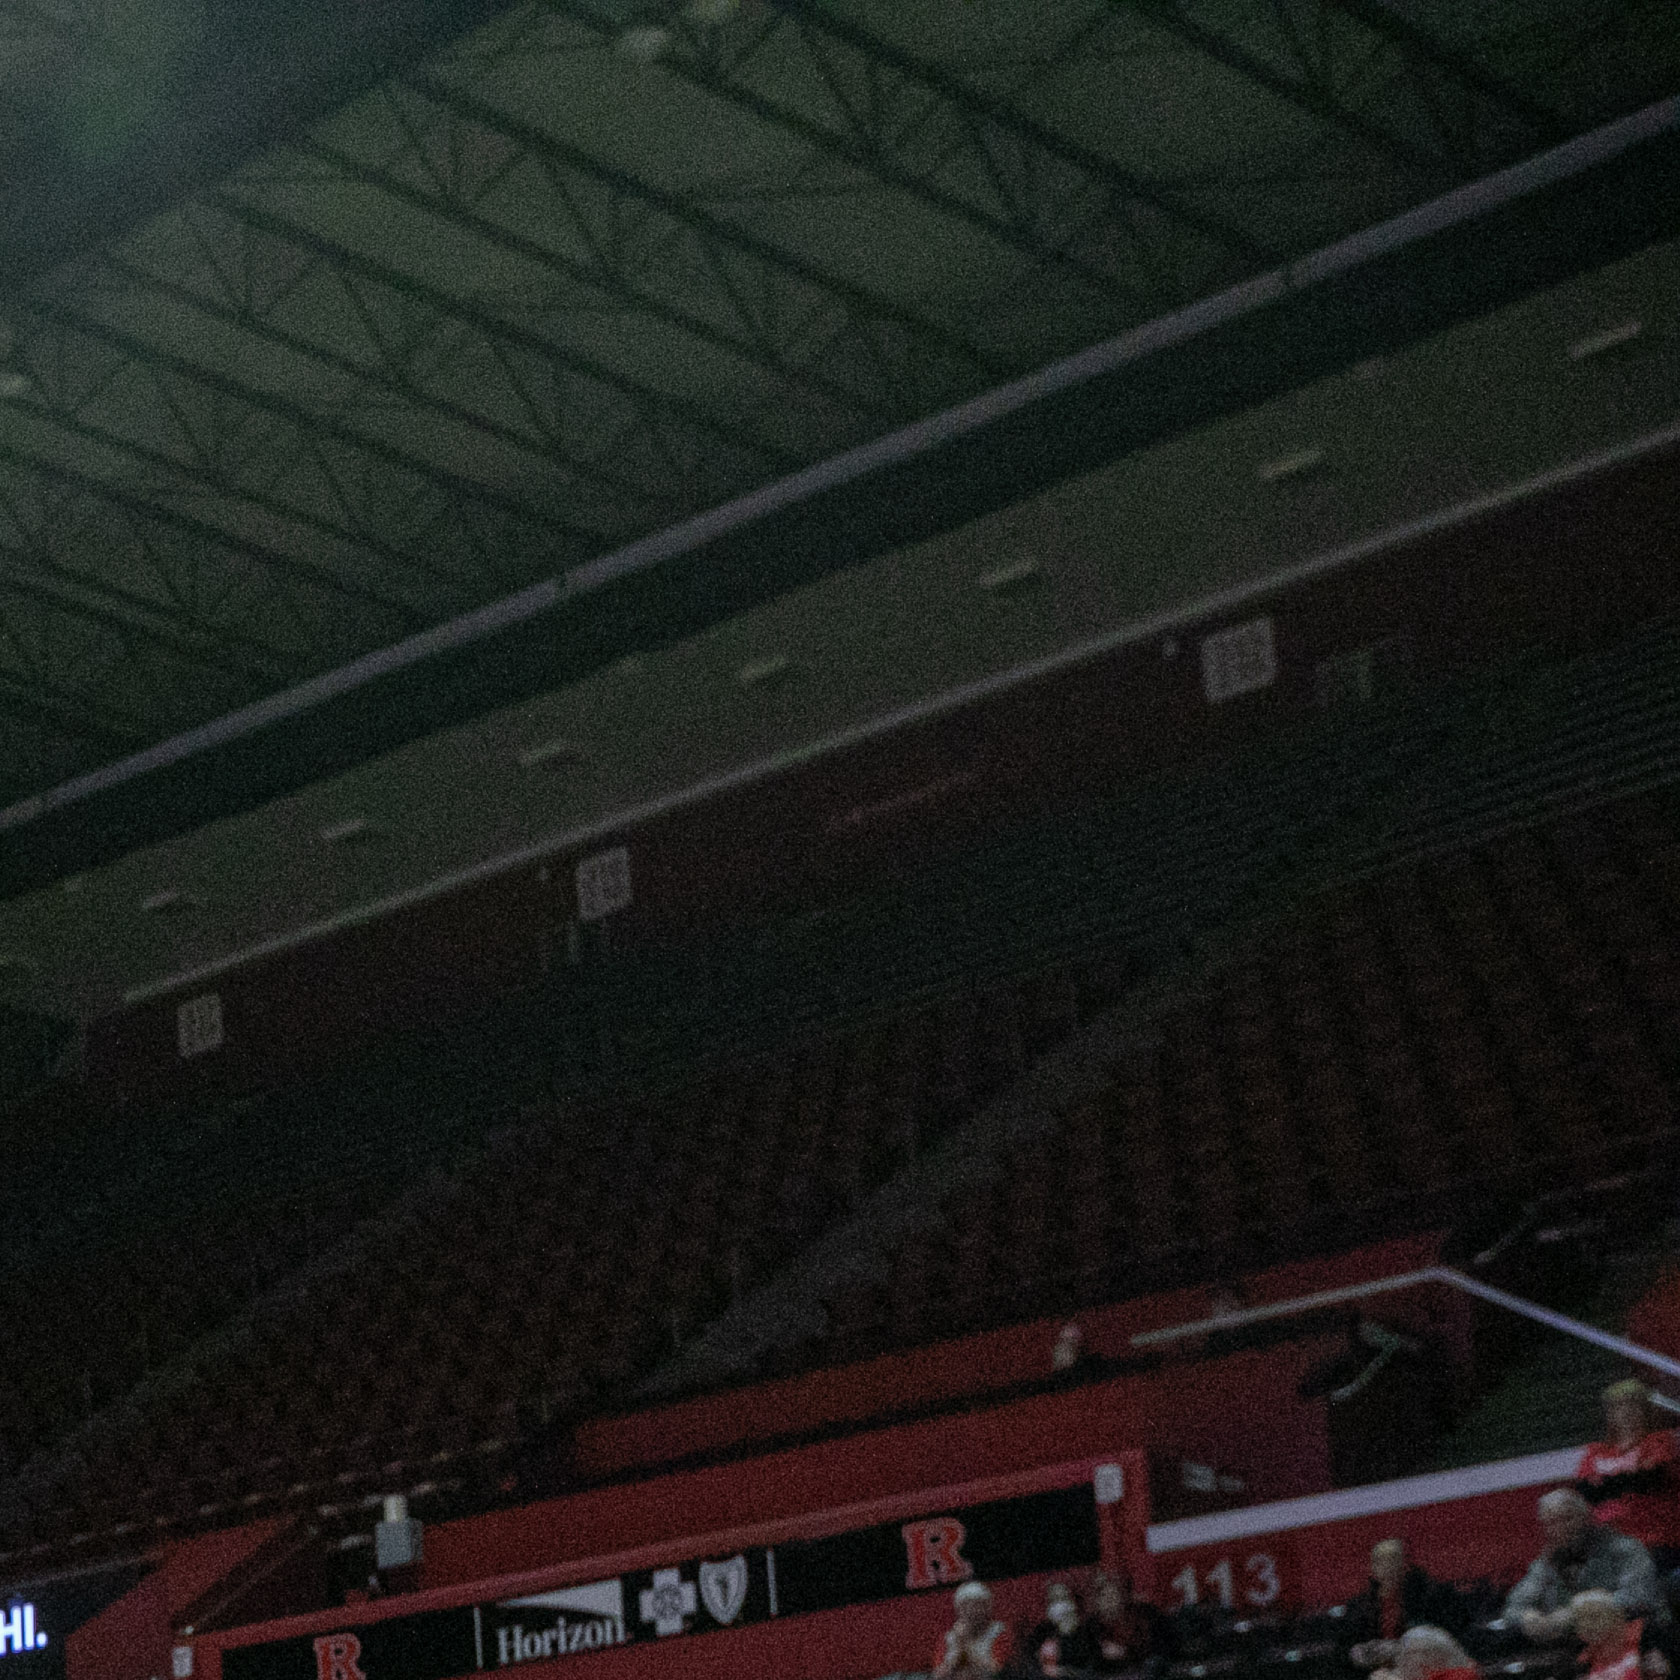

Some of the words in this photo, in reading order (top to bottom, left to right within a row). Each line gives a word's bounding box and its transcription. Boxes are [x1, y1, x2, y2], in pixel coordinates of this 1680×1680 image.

[901, 1516, 974, 1590] R
[1171, 1553, 1281, 1608] 113
[496, 1612, 627, 1667] Horizon
